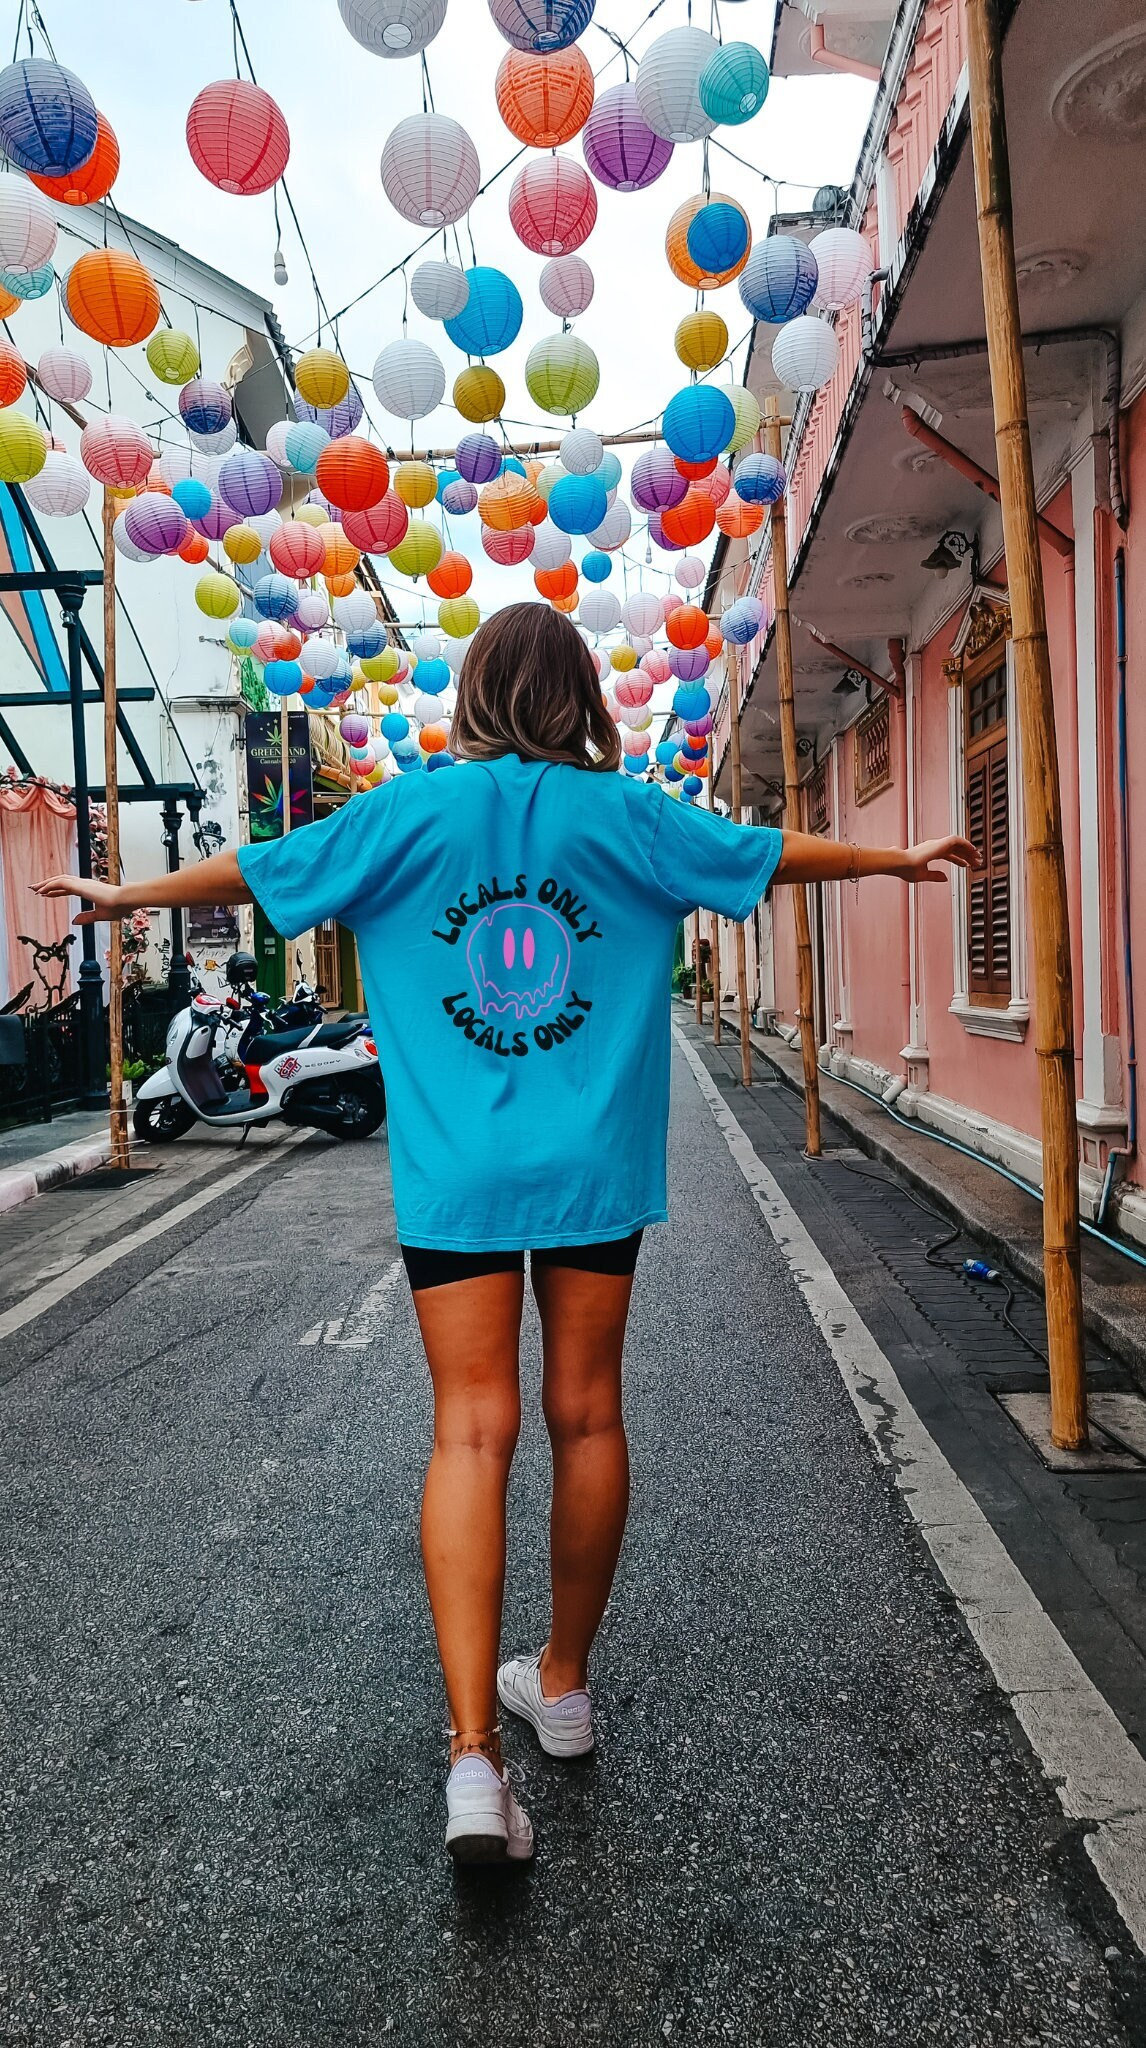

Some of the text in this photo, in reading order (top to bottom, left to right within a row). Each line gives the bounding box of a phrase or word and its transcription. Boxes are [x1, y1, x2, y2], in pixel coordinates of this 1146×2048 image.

[250, 747, 306, 757] GREENAND
[432, 874, 603, 945] LOCALS ONLY
[442, 990, 593, 1057] LOCALS ONLY
[455, 1769, 490, 1782] Reebok
